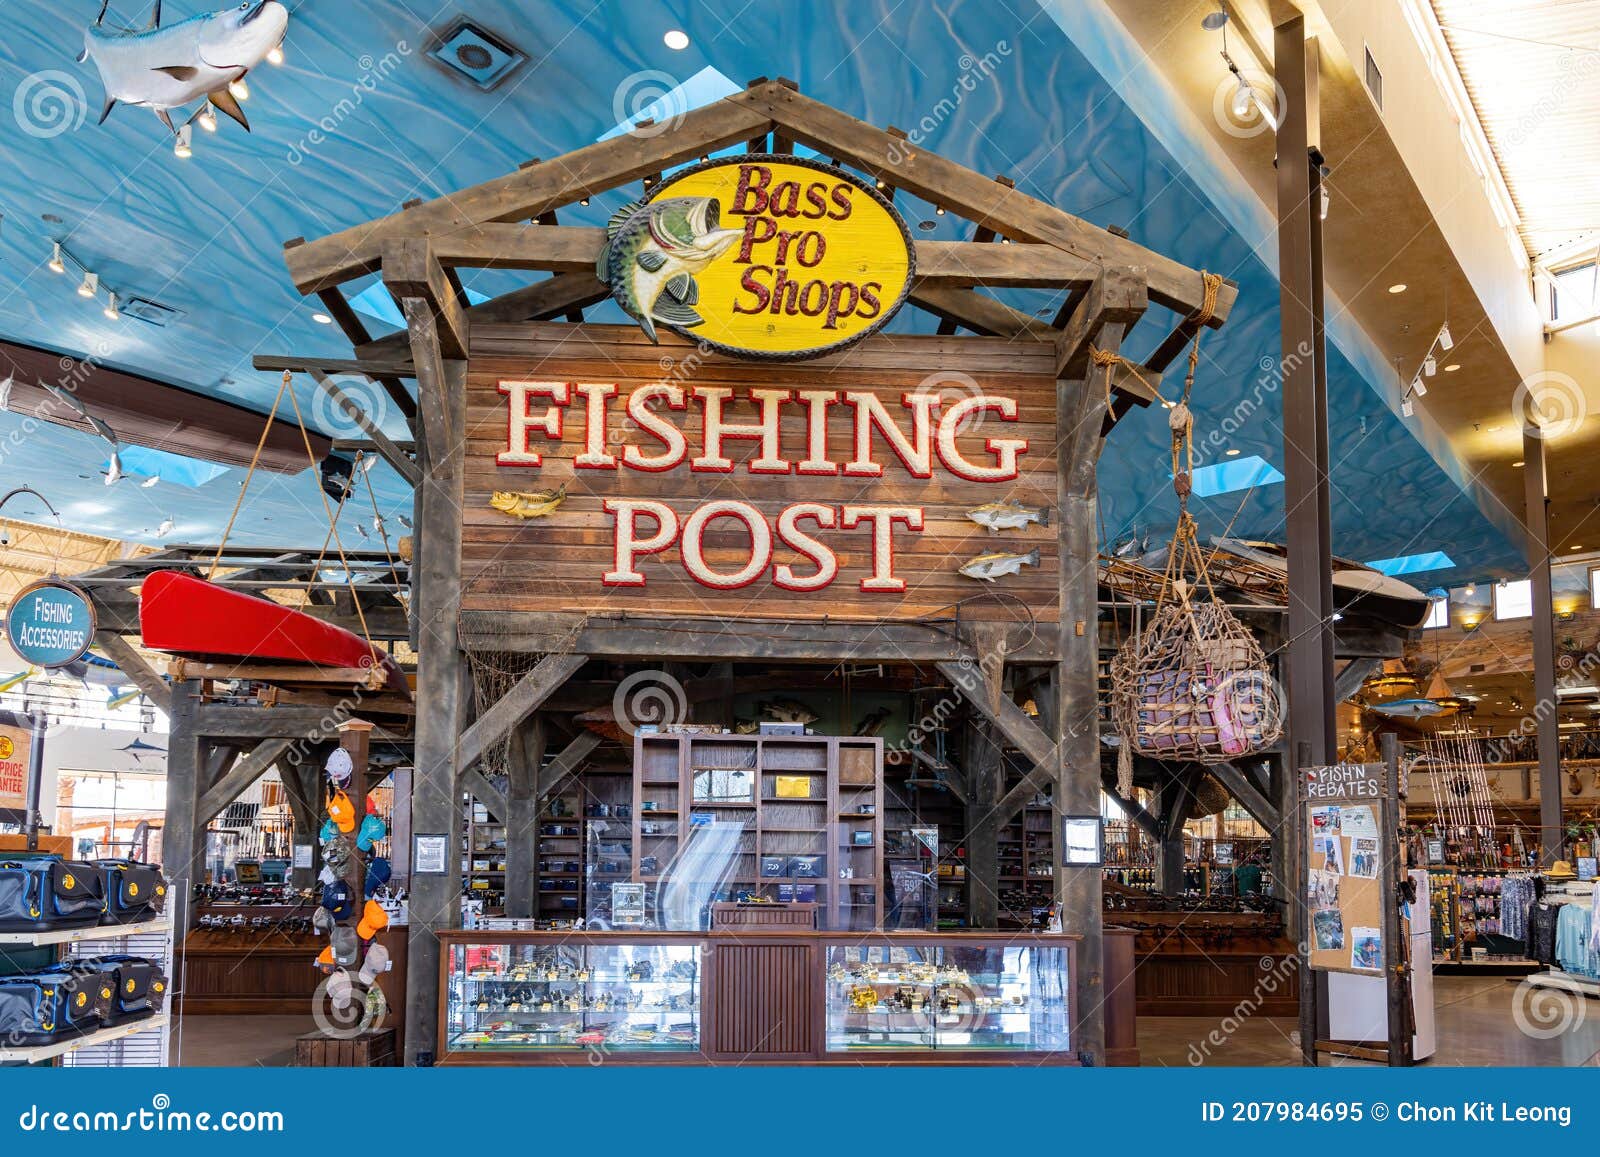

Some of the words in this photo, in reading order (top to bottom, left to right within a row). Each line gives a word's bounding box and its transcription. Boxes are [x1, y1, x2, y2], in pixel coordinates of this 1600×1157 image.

[728, 165, 853, 221] Bass
[733, 216, 827, 267] Pro
[733, 265, 882, 330] Shops
[495, 381, 1029, 483] FISHING
[602, 498, 925, 593] POST
[20, 622, 84, 650] ACCESSORIES
[34, 597, 73, 625] FISHING
[1308, 779, 1378, 798] REBATES
